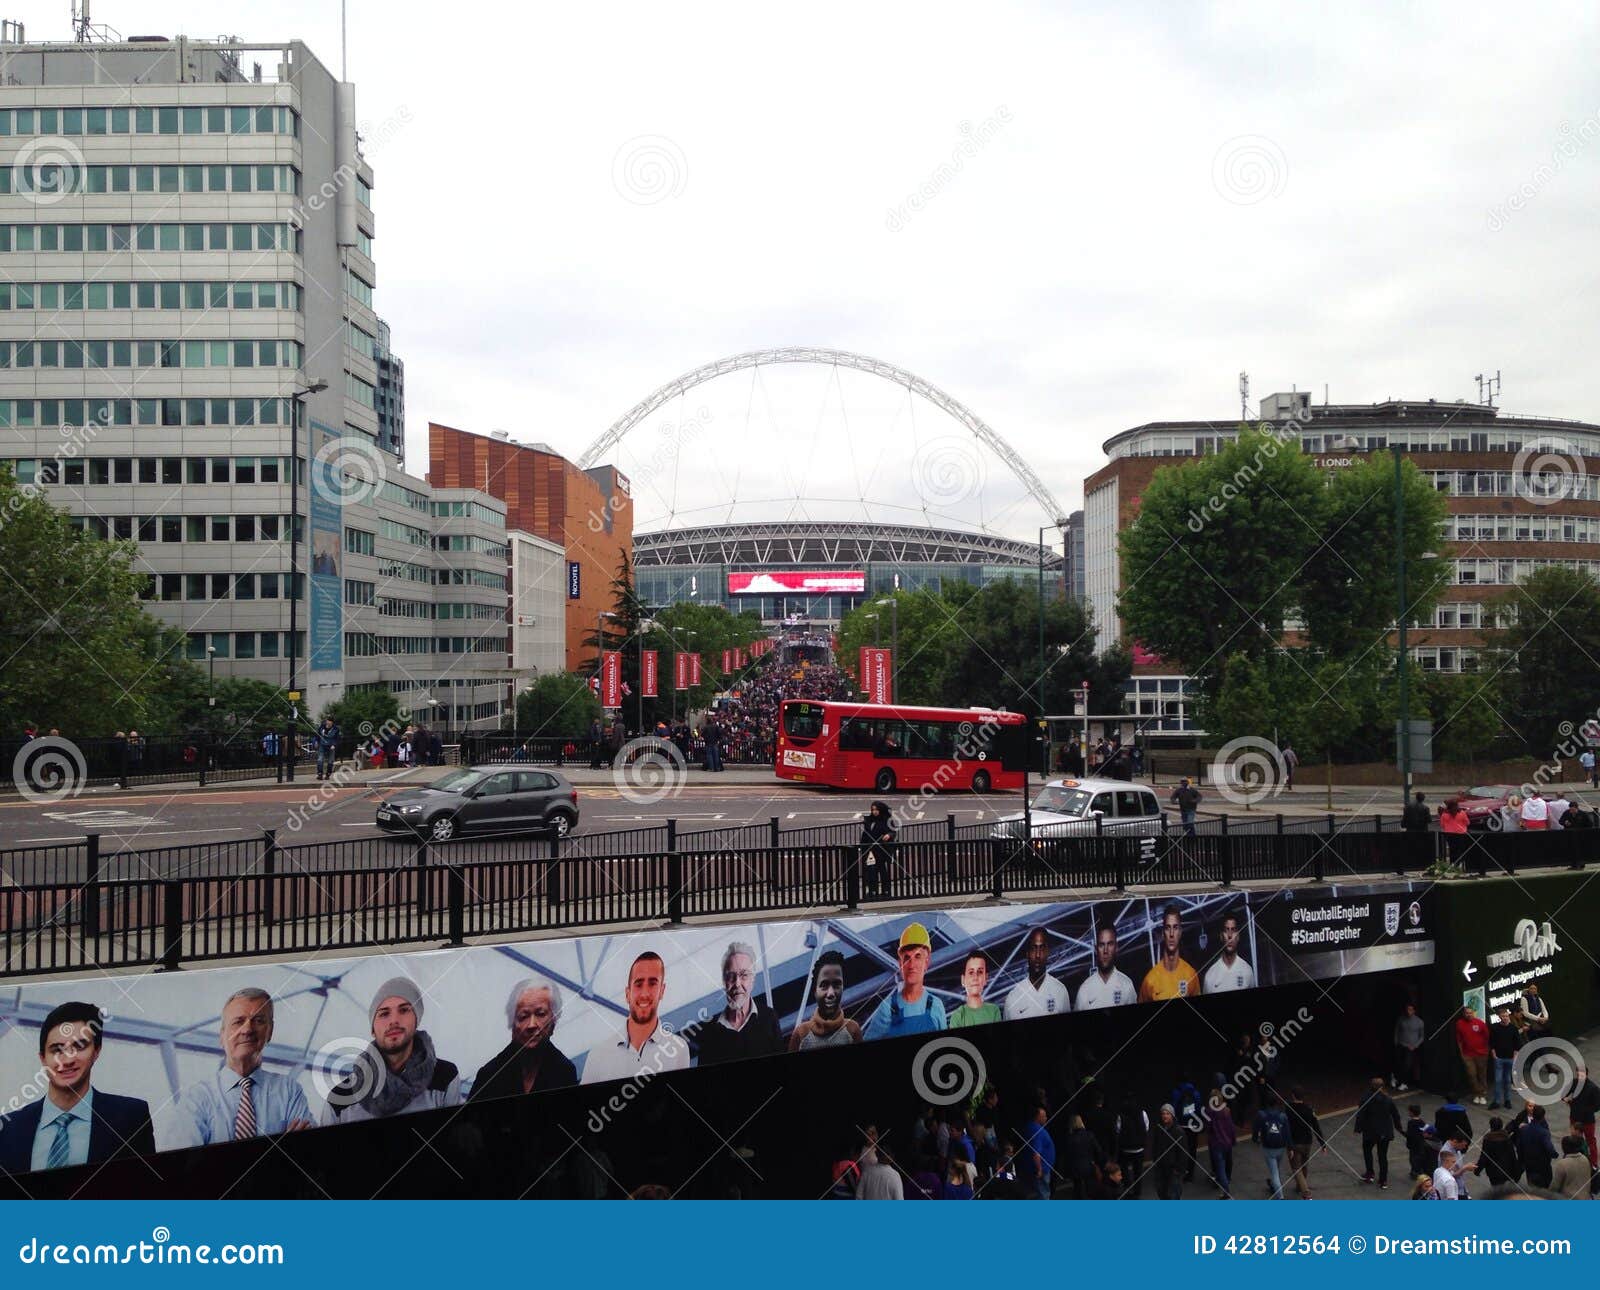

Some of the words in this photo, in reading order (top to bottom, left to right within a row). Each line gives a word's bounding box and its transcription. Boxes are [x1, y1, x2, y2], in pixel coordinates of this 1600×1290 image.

[1291, 903, 1370, 924] @VauxhallEngland
[1291, 926, 1362, 945] #StandTogether
[1513, 919, 1562, 962] Park
[1489, 977, 1511, 991] London
[1511, 969, 1535, 984] Designer
[1535, 963, 1553, 977] Outlet
[1490, 992, 1516, 1008] Wembley
